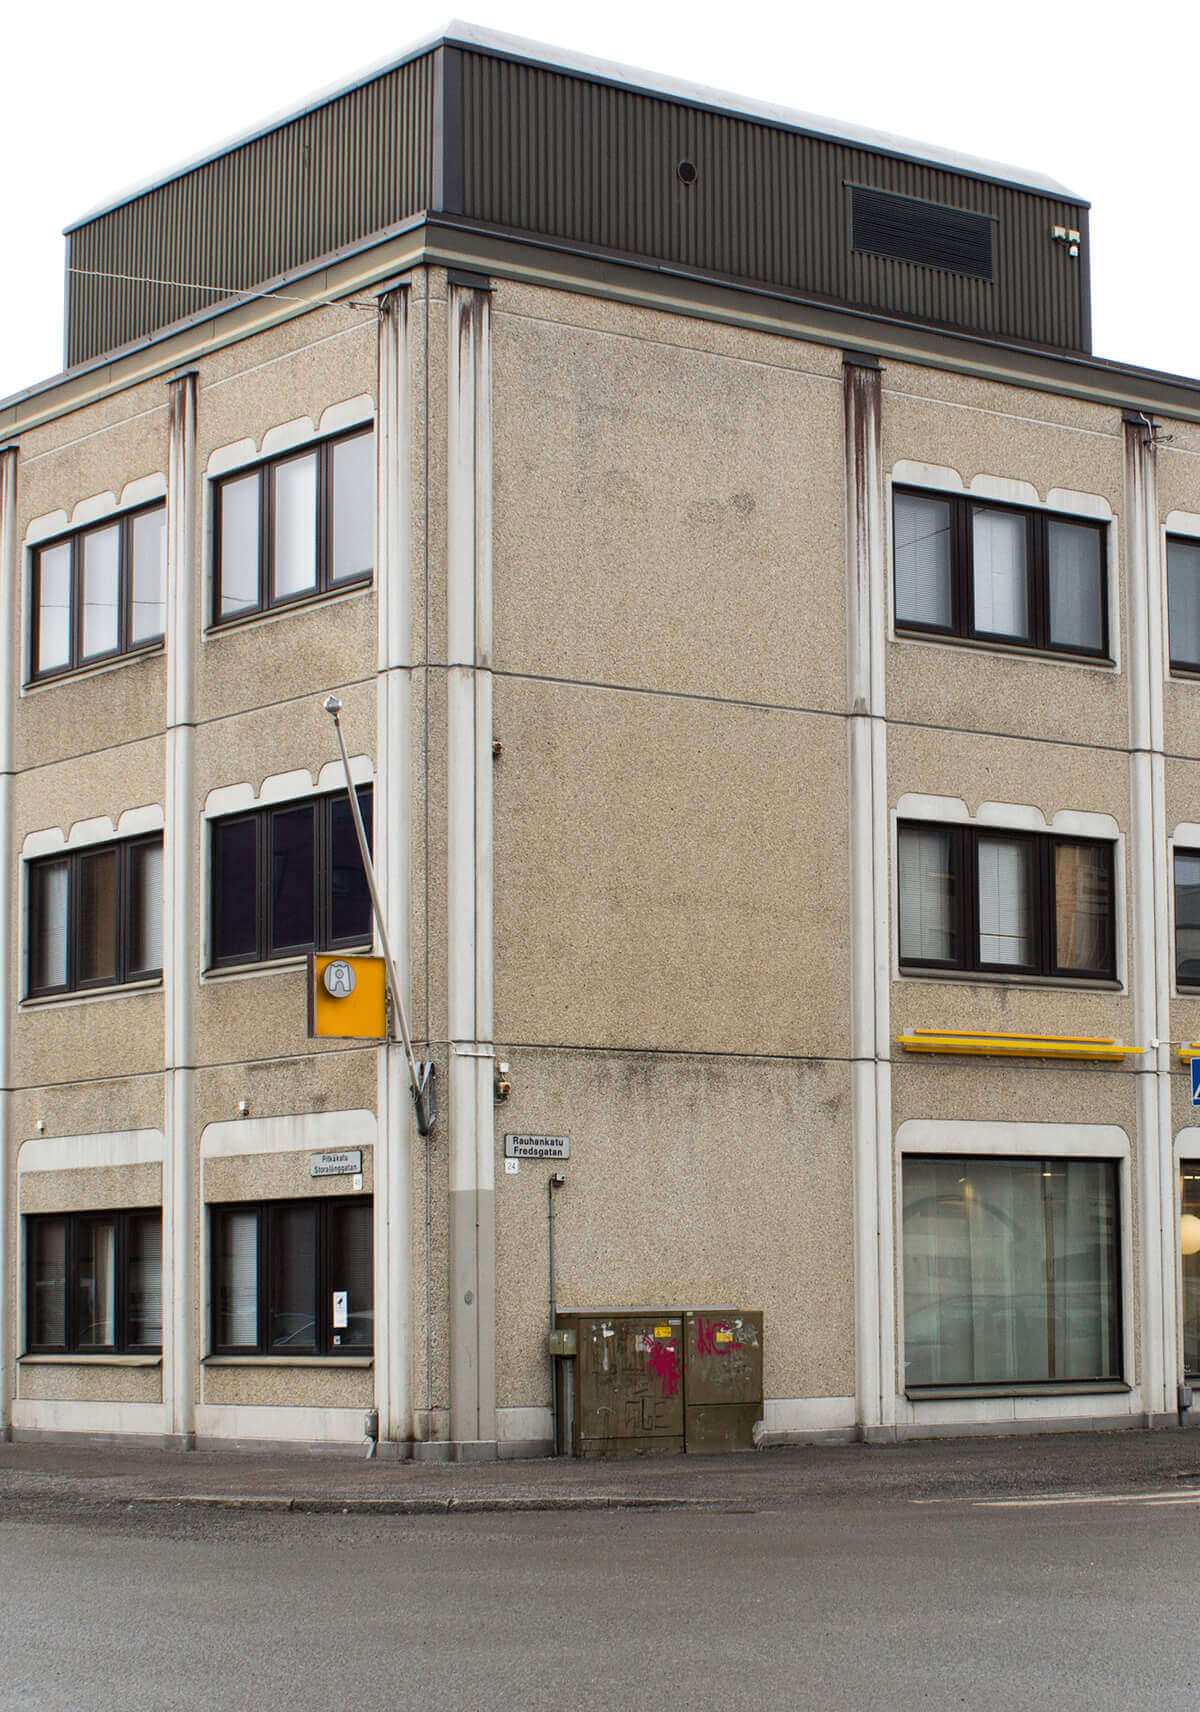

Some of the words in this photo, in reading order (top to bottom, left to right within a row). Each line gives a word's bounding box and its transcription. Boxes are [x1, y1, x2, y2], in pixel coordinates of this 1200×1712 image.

[512, 1136, 564, 1146] Rauhankatu
[513, 1146, 563, 1157] Fredsgatan
[507, 1162, 517, 1170] 24
